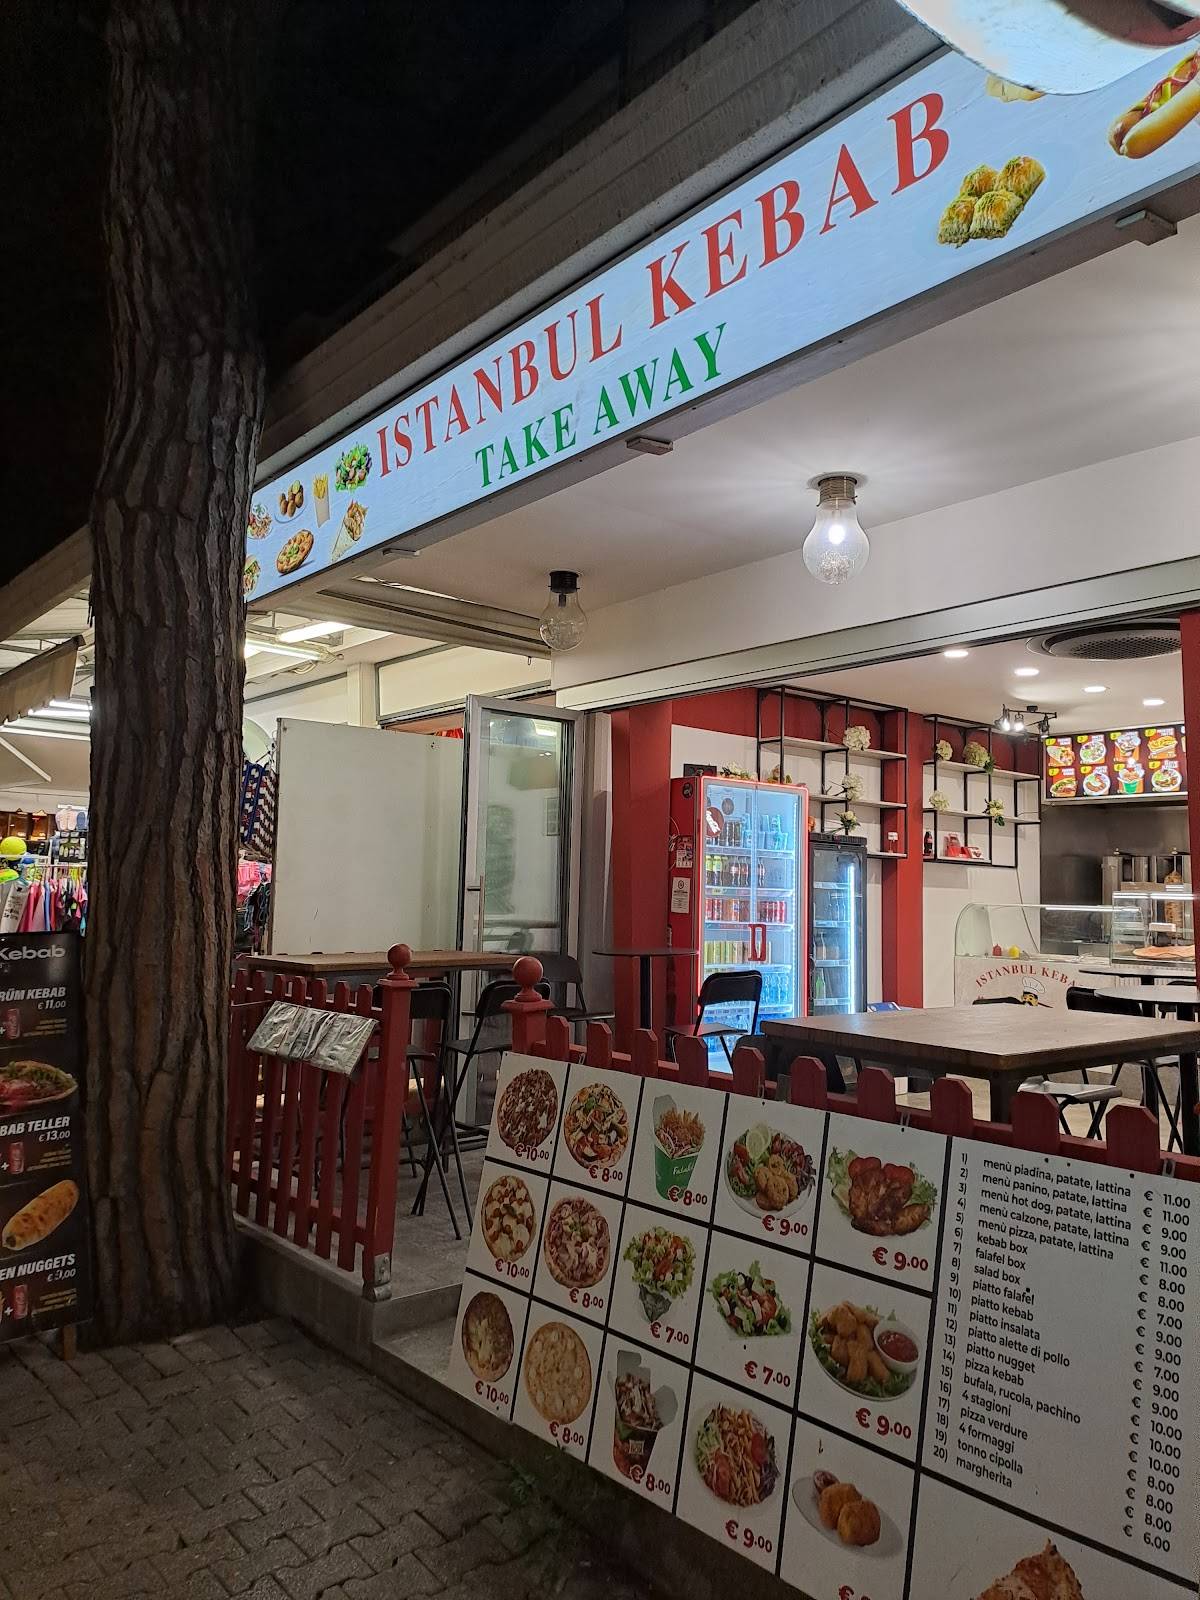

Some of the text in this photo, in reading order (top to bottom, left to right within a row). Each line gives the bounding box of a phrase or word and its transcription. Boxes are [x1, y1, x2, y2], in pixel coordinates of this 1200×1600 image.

[377, 93, 950, 477] ISTANBUL KEBAB
[475, 322, 727, 489] TAKE AWAY
[26, 987, 66, 1000] KEBAB
[45, 999, 66, 1010] 11,00
[975, 964, 1037, 988] ISTANBUL
[27, 1116, 70, 1132] TELLER
[46, 1130, 71, 1141] 13,00
[527, 1146, 550, 1162] 10.00
[589, 1165, 623, 1182] € 8.00
[961, 1152, 968, 1166] 1)
[983, 1159, 1013, 1173] menù
[1055, 1173, 1094, 1192] patate,
[1095, 1179, 1132, 1198] lattina
[1143, 1190, 1154, 1202] €
[1162, 1193, 1191, 1210] 11.00
[683, 1190, 708, 1206] 8.00
[762, 1214, 808, 1236] € 9.00
[957, 1181, 1188, 1243] 3) menù hot dog, patate, lattina € 9.00
[959, 1167, 1190, 1227] 2) menù panino, patate, lattina € 11.00
[872, 1246, 928, 1271] € 9.00
[955, 1211, 1188, 1279] 5) menù pizza, patate, lattina € 11.00
[956, 1197, 1187, 1261] 4) menù calzone, patate, lattina € 9.00
[17, 1253, 76, 1277] NUGGETS
[507, 1262, 530, 1278] 10.00
[952, 1241, 1185, 1313] 7) falafel box € 8.00
[954, 1226, 1186, 1296] 6) kebab box € 8.00
[569, 1288, 604, 1308] € 8.00
[949, 1271, 1183, 1349] 9) piatto falafel € 9.00
[951, 1256, 1183, 1331] 8) salad box € 7.00
[650, 1322, 690, 1344] € 7.00
[947, 1301, 1180, 1385] 11) piatto insalata € 7.00
[948, 1286, 1182, 1367] 10) piatto kebab € 9.00
[744, 1361, 790, 1387] € 7.00
[943, 1332, 1179, 1421] 13) piatto nugget € 9.00
[945, 1317, 1180, 1403] 12) piatto alette di pollo € 9.00
[486, 1384, 509, 1404] 10.00
[856, 1408, 912, 1439] € 9.00
[940, 1363, 1182, 1461] 15) bufala, rucola, pachino € 10.00
[942, 1347, 1183, 1442] 14) pizza kebab € 10.00
[562, 1426, 584, 1446] 8.00
[937, 1395, 1175, 1496] 17) pizza verdure € 8.00
[939, 1379, 1181, 1479] 16) 4 stagioni € 10.00
[646, 1474, 670, 1494] 8.00
[934, 1427, 1172, 1534] 19) tonno cipolla € 8.00
[936, 1411, 1174, 1515] 18) 4 formaggi € 8.00
[933, 1446, 1171, 1553] 20) margherita € 6.00
[726, 1520, 772, 1552] € 9.00
